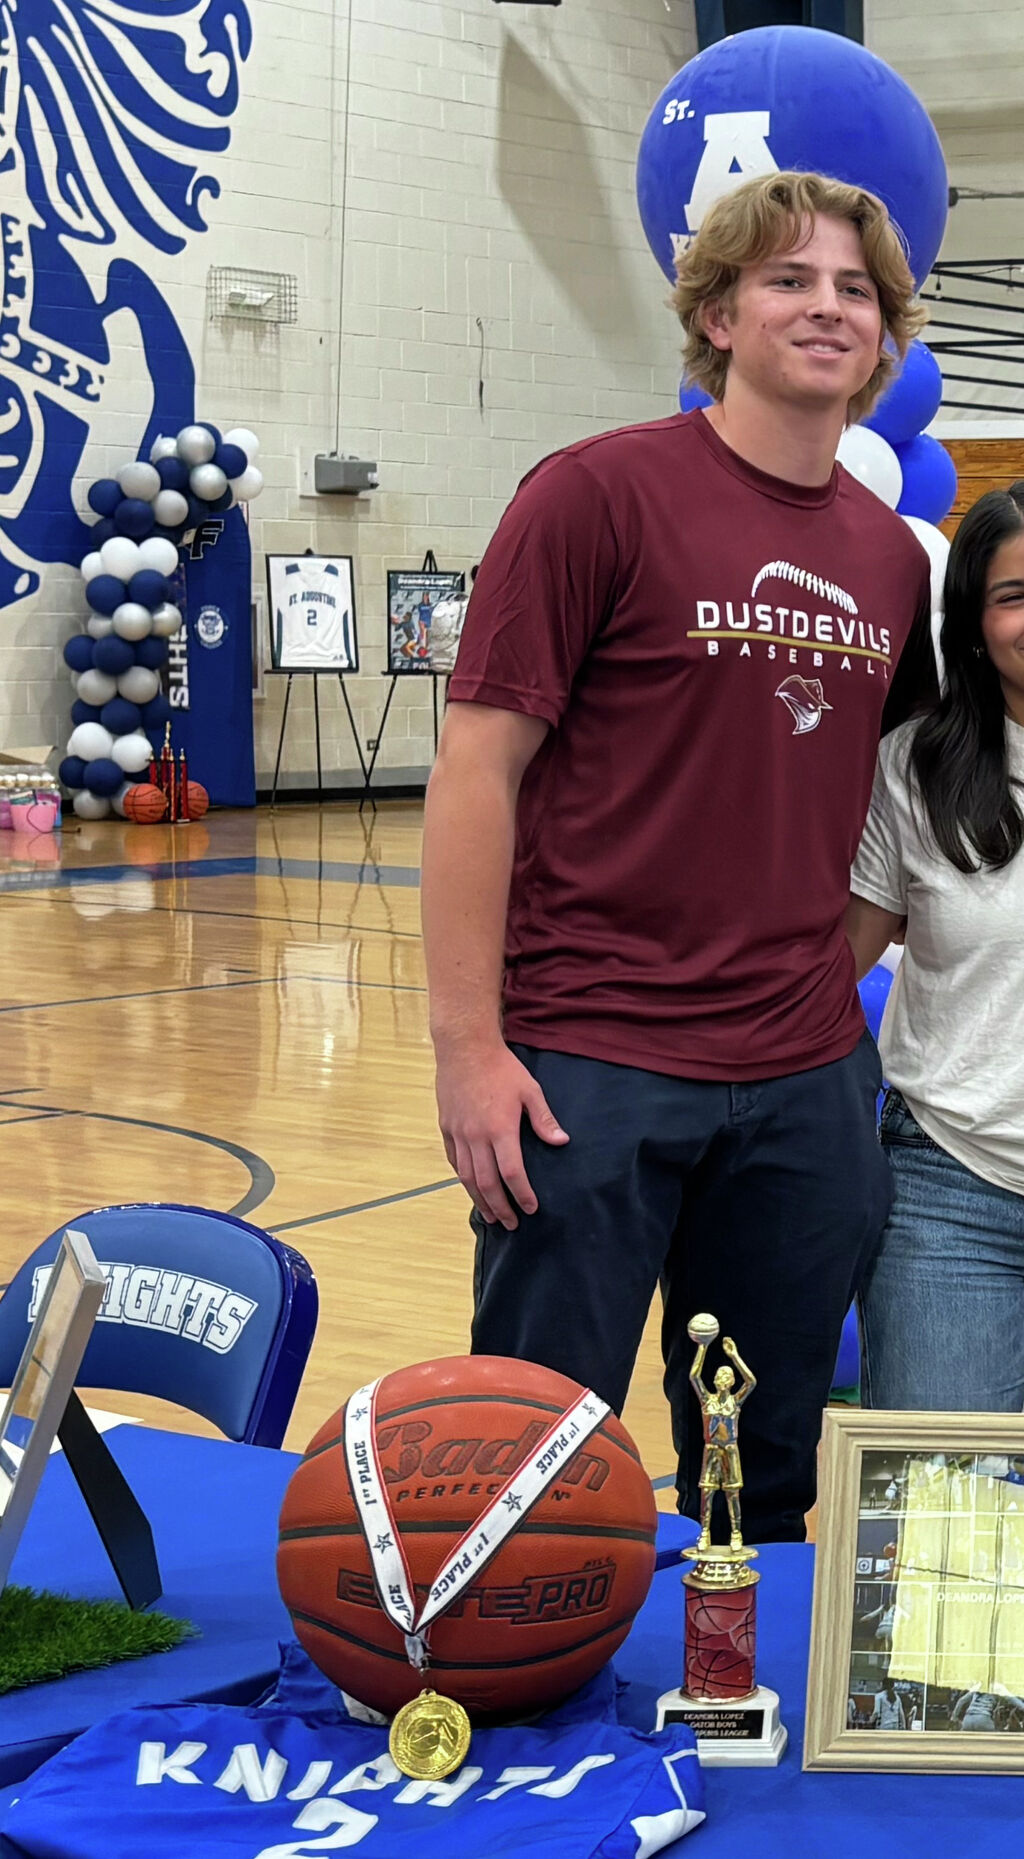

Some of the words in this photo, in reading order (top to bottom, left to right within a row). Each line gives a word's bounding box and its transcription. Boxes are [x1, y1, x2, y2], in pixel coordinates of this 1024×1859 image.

[662, 99, 695, 125] ST.
[306, 609, 317, 626] 2
[696, 600, 891, 655] DUSTDEVILS
[353, 1440, 372, 1485] PLACE
[377, 1420, 611, 1492] Badn
[535, 1433, 570, 1475] PLACE
[429, 1552, 473, 1602] PLACE
[536, 1573, 610, 1617] PRO
[937, 1592, 994, 1603] DEANDRA
[253, 1797, 380, 1859] 2
